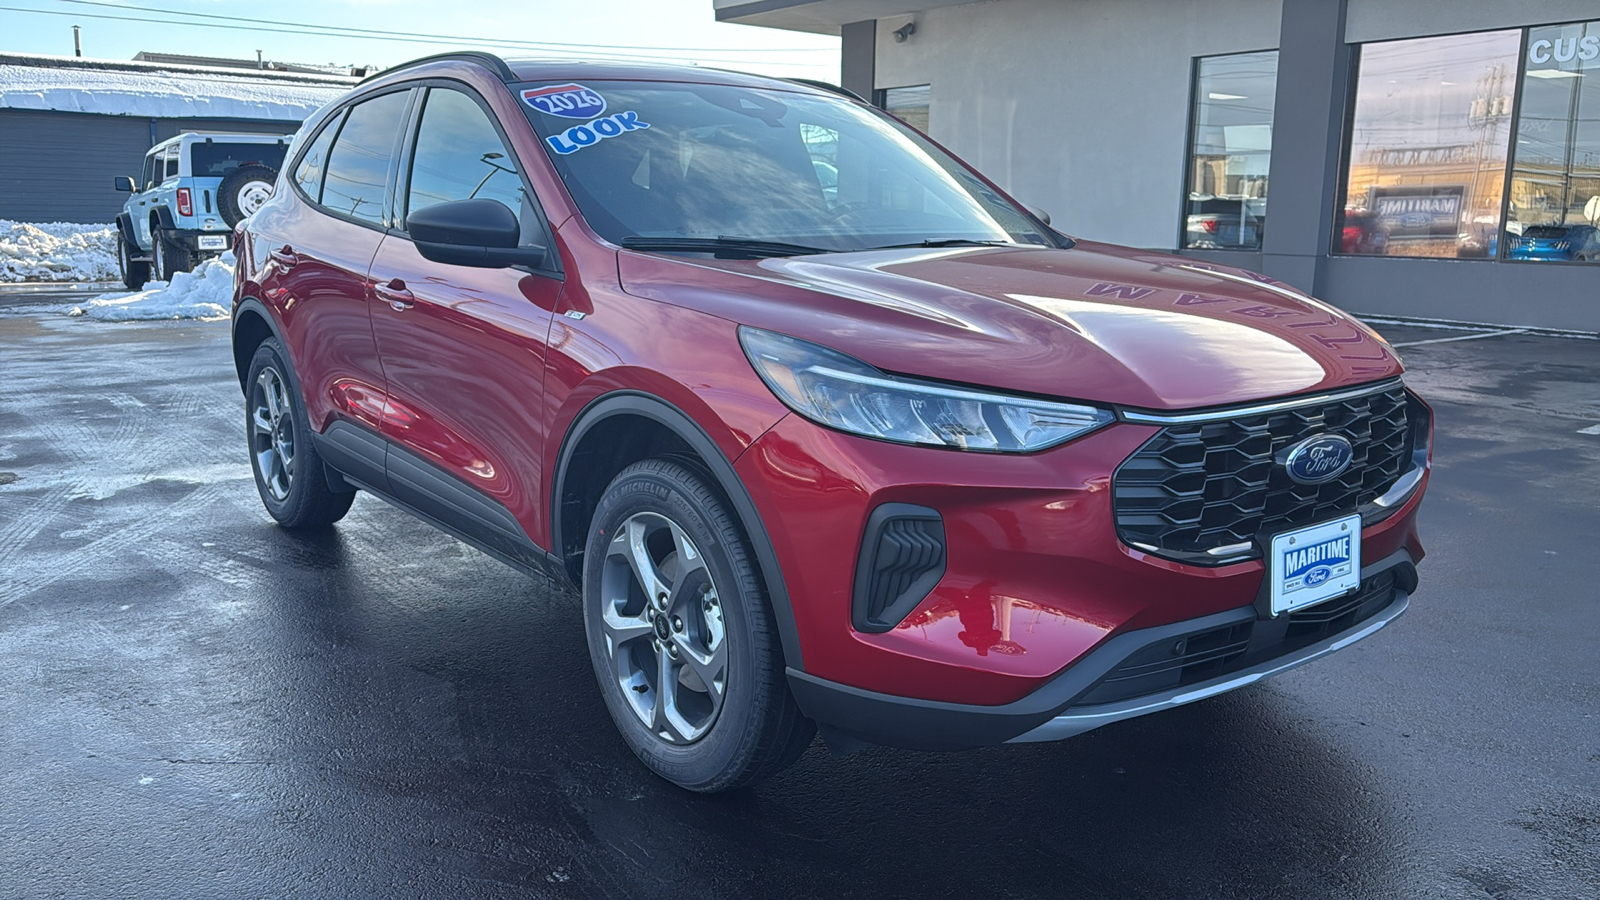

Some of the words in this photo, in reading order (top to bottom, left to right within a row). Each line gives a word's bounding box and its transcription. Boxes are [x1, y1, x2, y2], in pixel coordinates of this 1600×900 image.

[535, 92, 602, 113] 2026
[547, 111, 649, 154] LOOK
[1305, 445, 1342, 475] Ford
[620, 481, 668, 499] MICHELIN
[674, 496, 698, 523] 225/60
[1286, 537, 1349, 577] MARITIME
[1307, 569, 1327, 584] Ford
